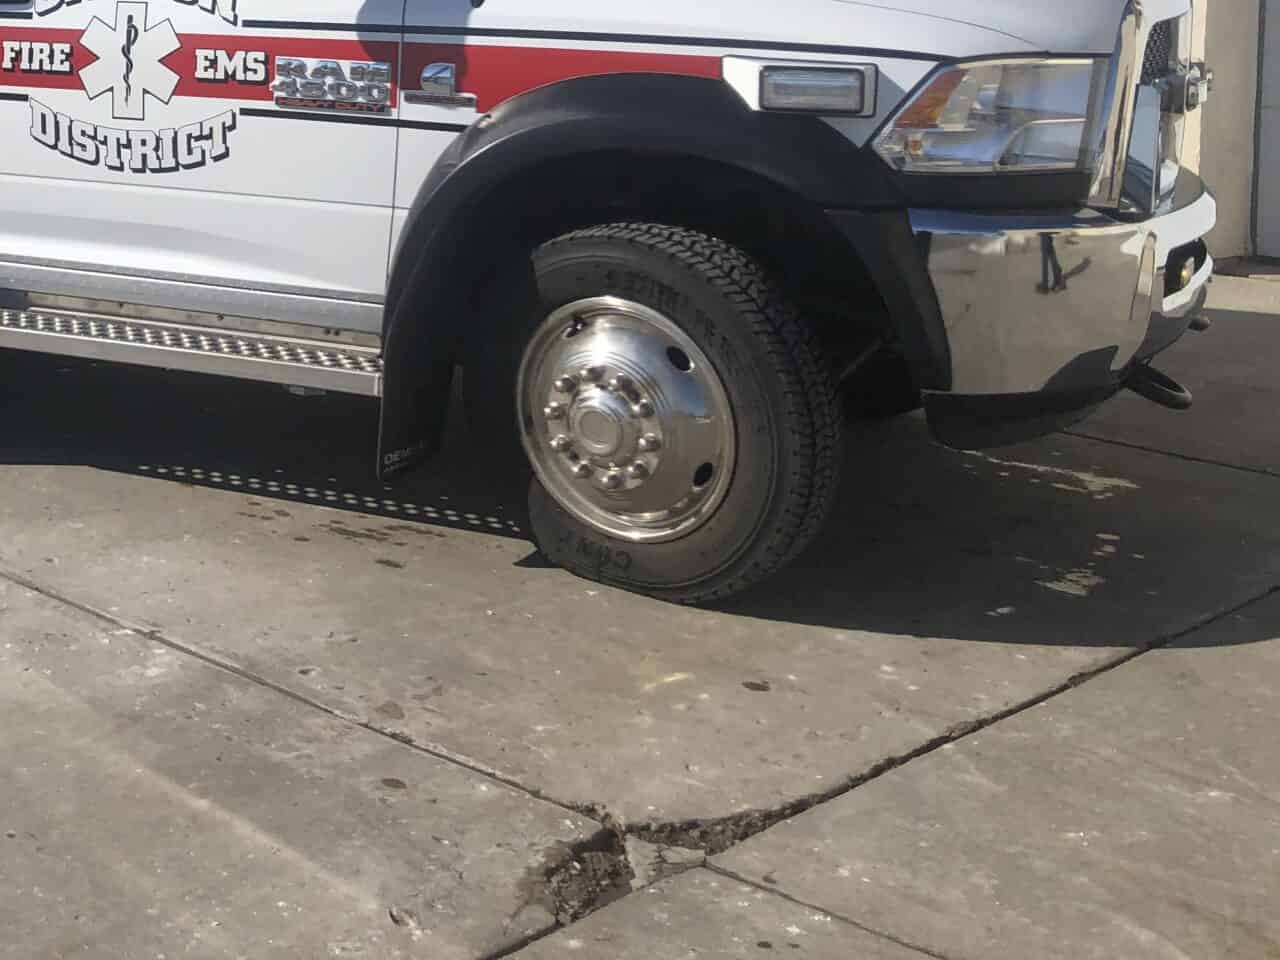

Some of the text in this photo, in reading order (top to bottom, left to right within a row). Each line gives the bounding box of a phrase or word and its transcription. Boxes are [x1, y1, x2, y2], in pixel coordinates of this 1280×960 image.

[1, 40, 268, 83] FIRE EMS
[29, 96, 237, 173] DISTRICT
